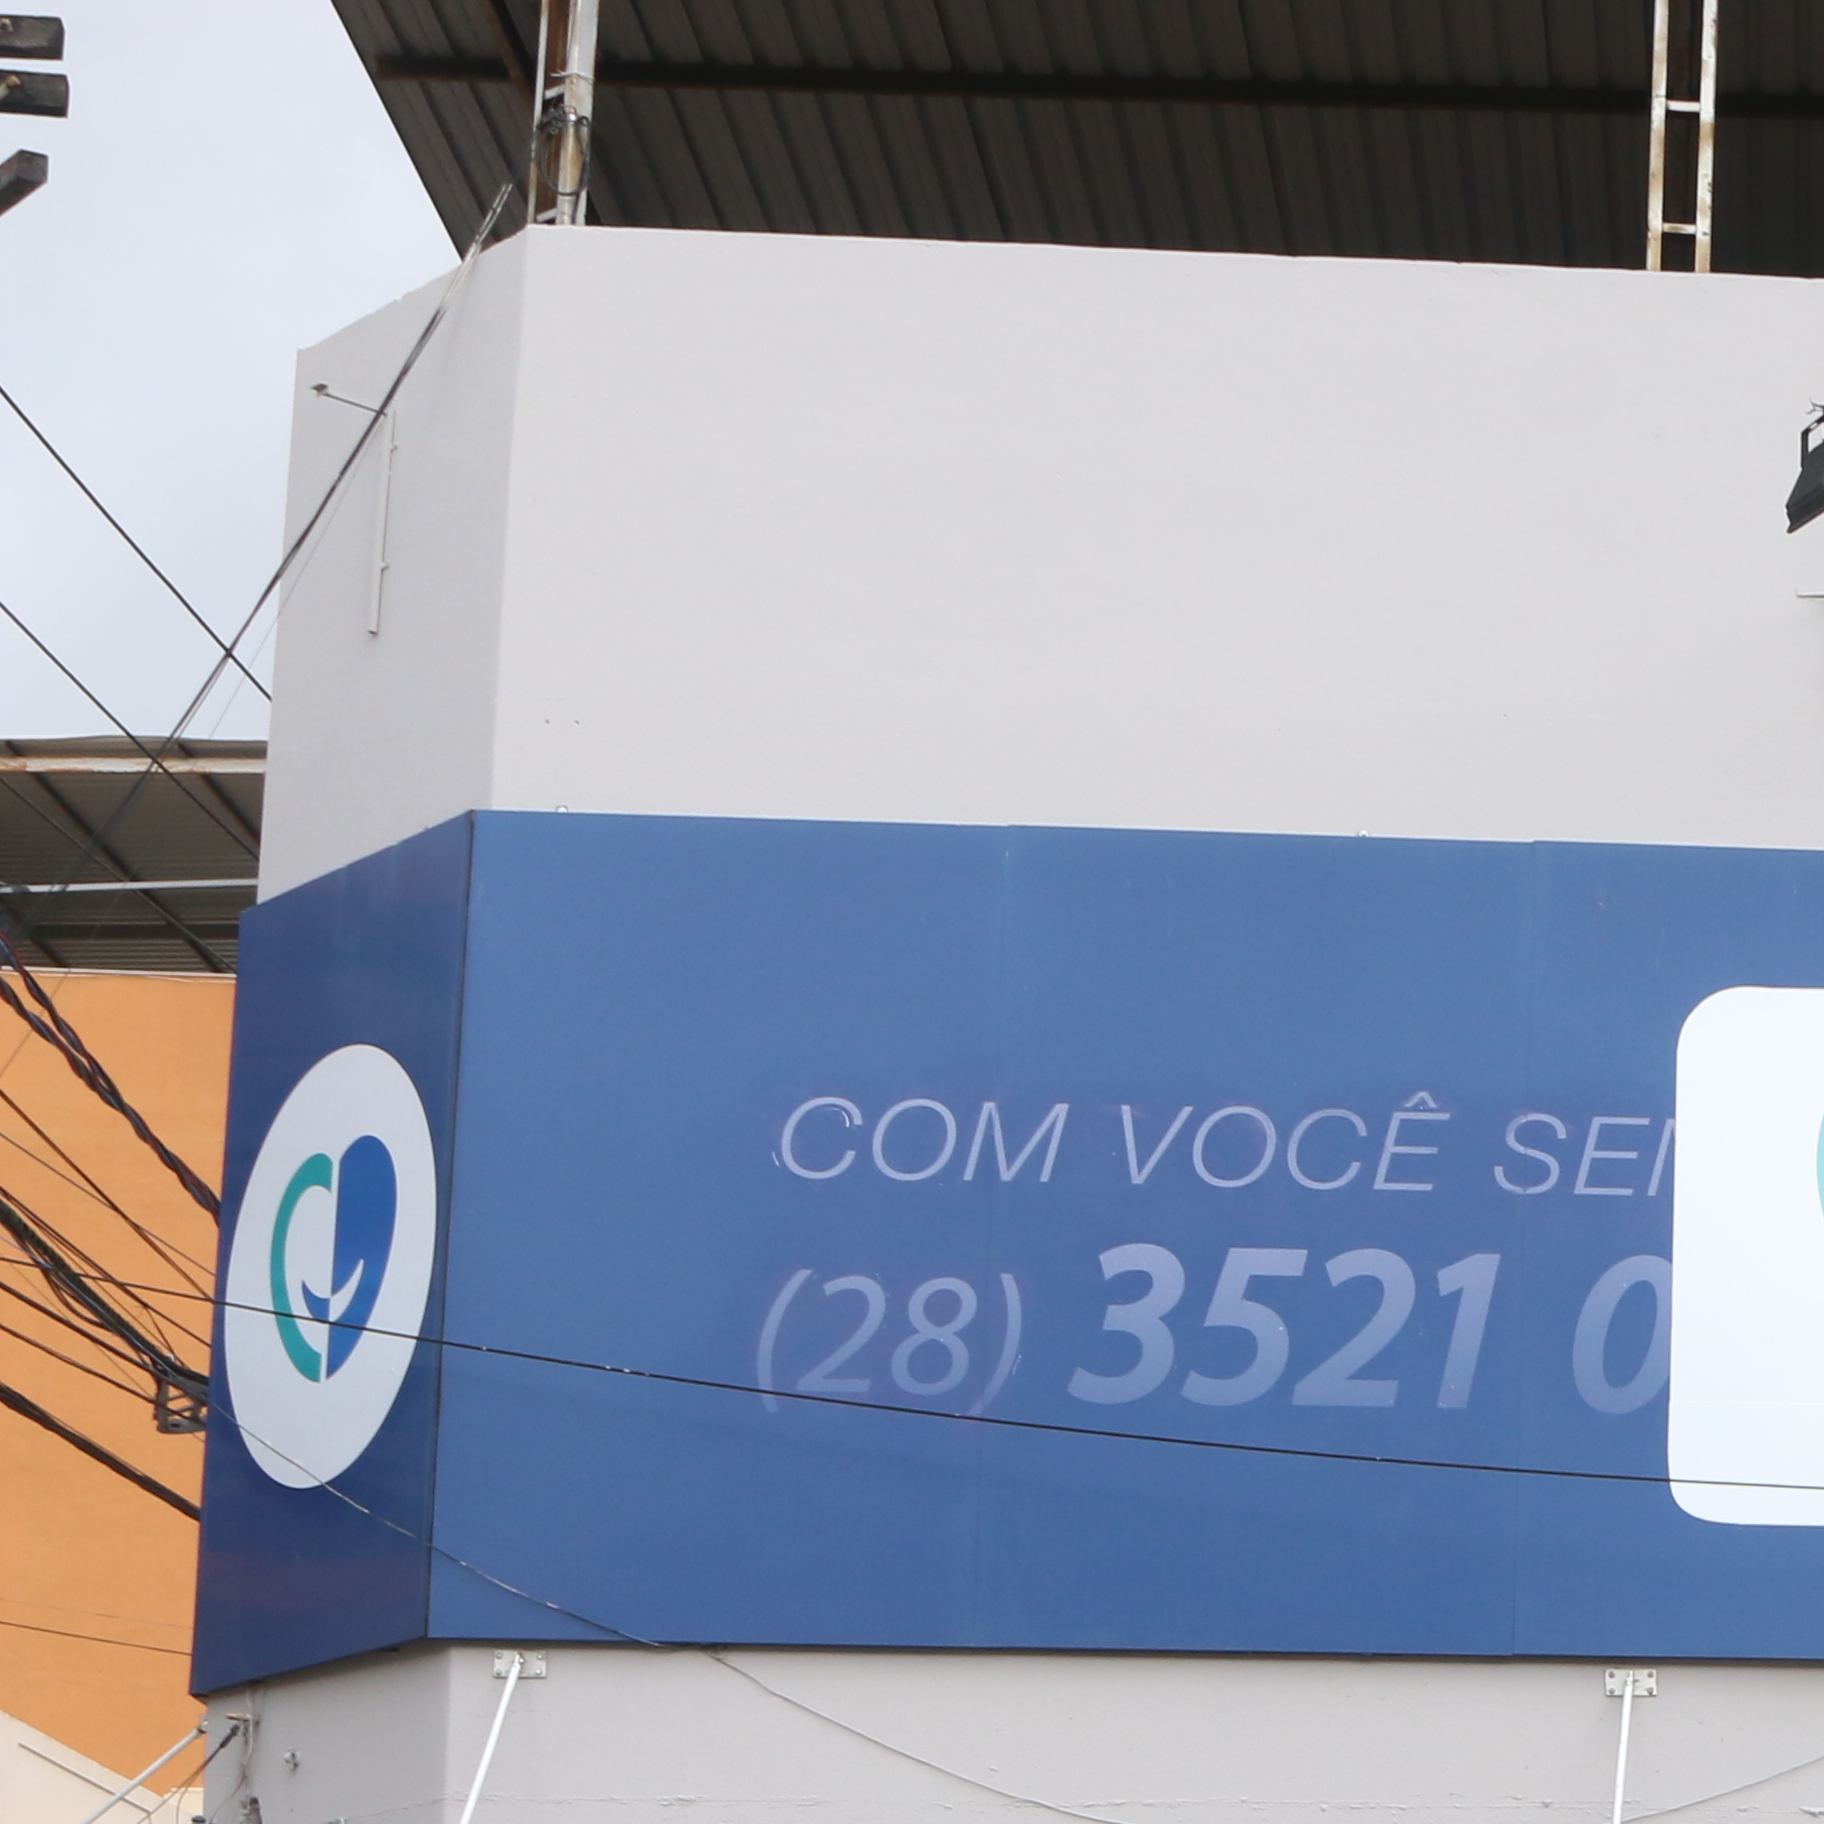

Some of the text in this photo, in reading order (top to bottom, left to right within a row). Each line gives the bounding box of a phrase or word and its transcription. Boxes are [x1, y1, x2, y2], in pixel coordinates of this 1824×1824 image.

[776, 1095, 1069, 1184] COM
[1118, 1090, 1451, 1192] VOCÊ
[756, 1268, 1024, 1418] (28)
[1066, 1241, 1502, 1410] 3521
